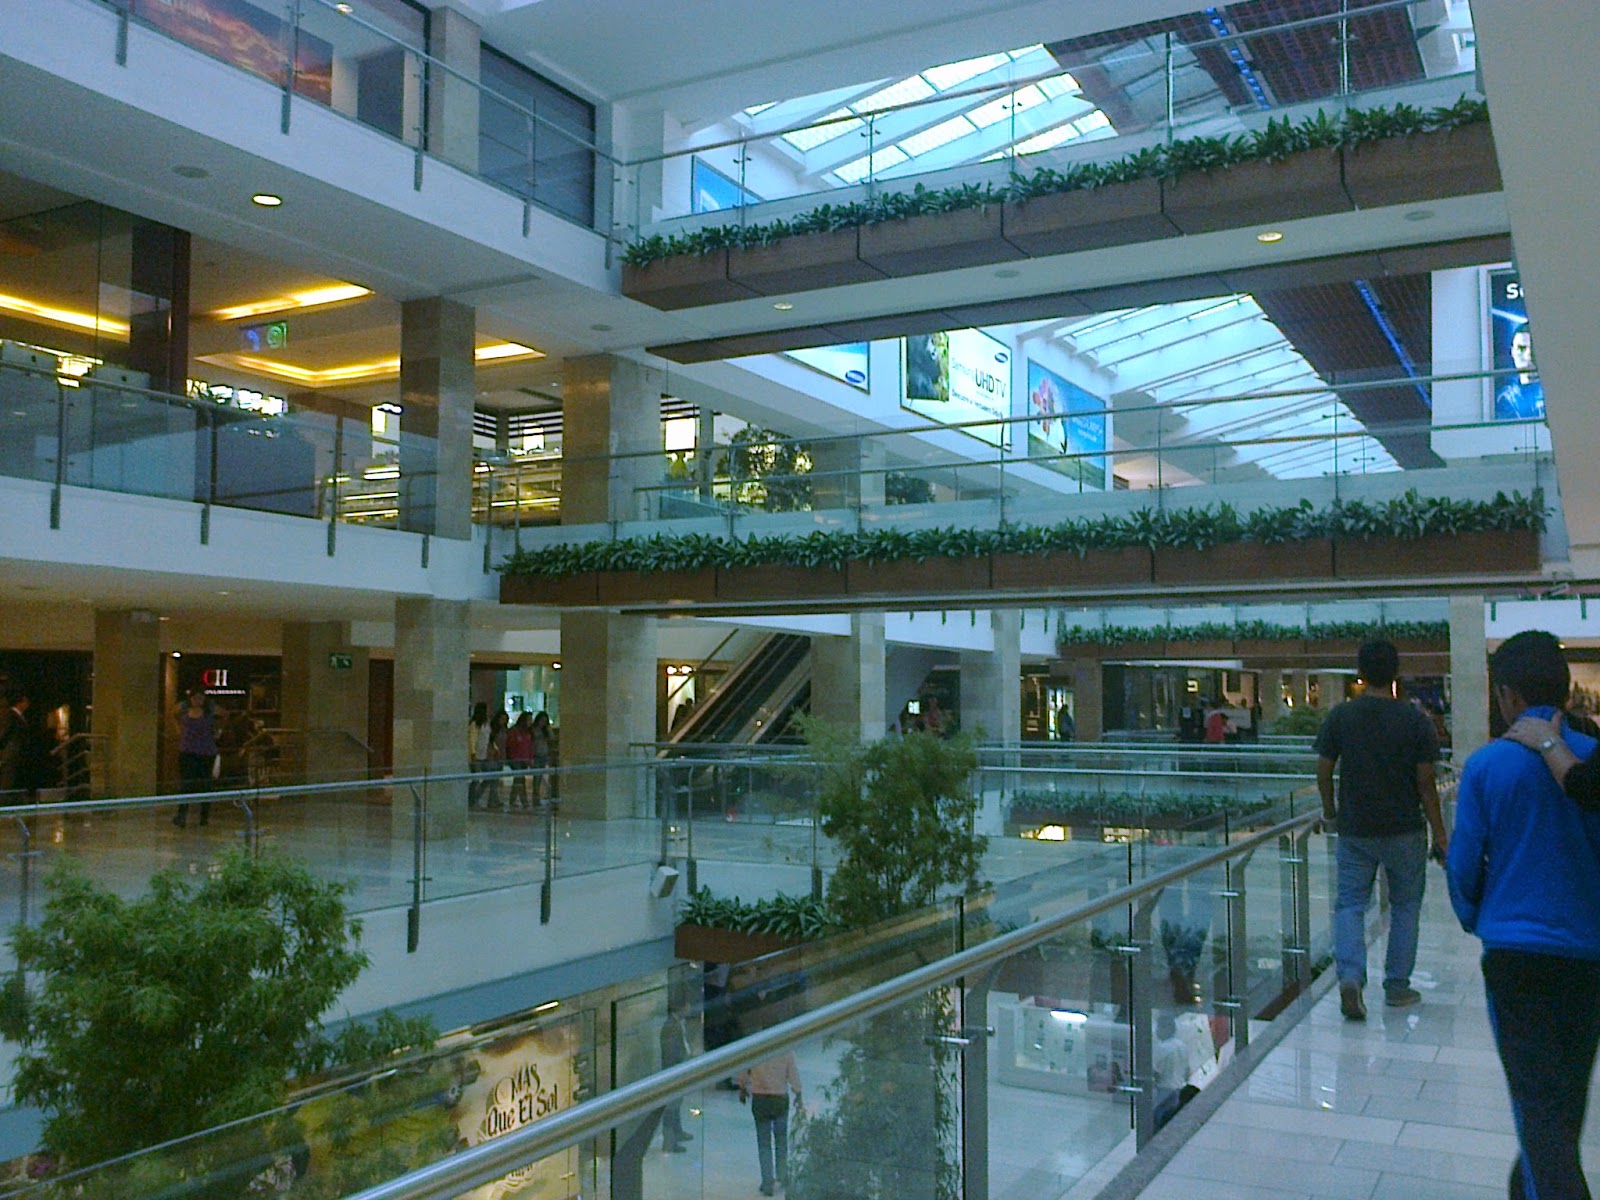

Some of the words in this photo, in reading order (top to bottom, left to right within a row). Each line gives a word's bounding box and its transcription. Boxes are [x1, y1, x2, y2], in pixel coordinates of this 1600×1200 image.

[975, 367, 994, 393] UHD
[487, 1105, 515, 1137] Que
[519, 1093, 533, 1124] El
[536, 1083, 559, 1117] Sol
